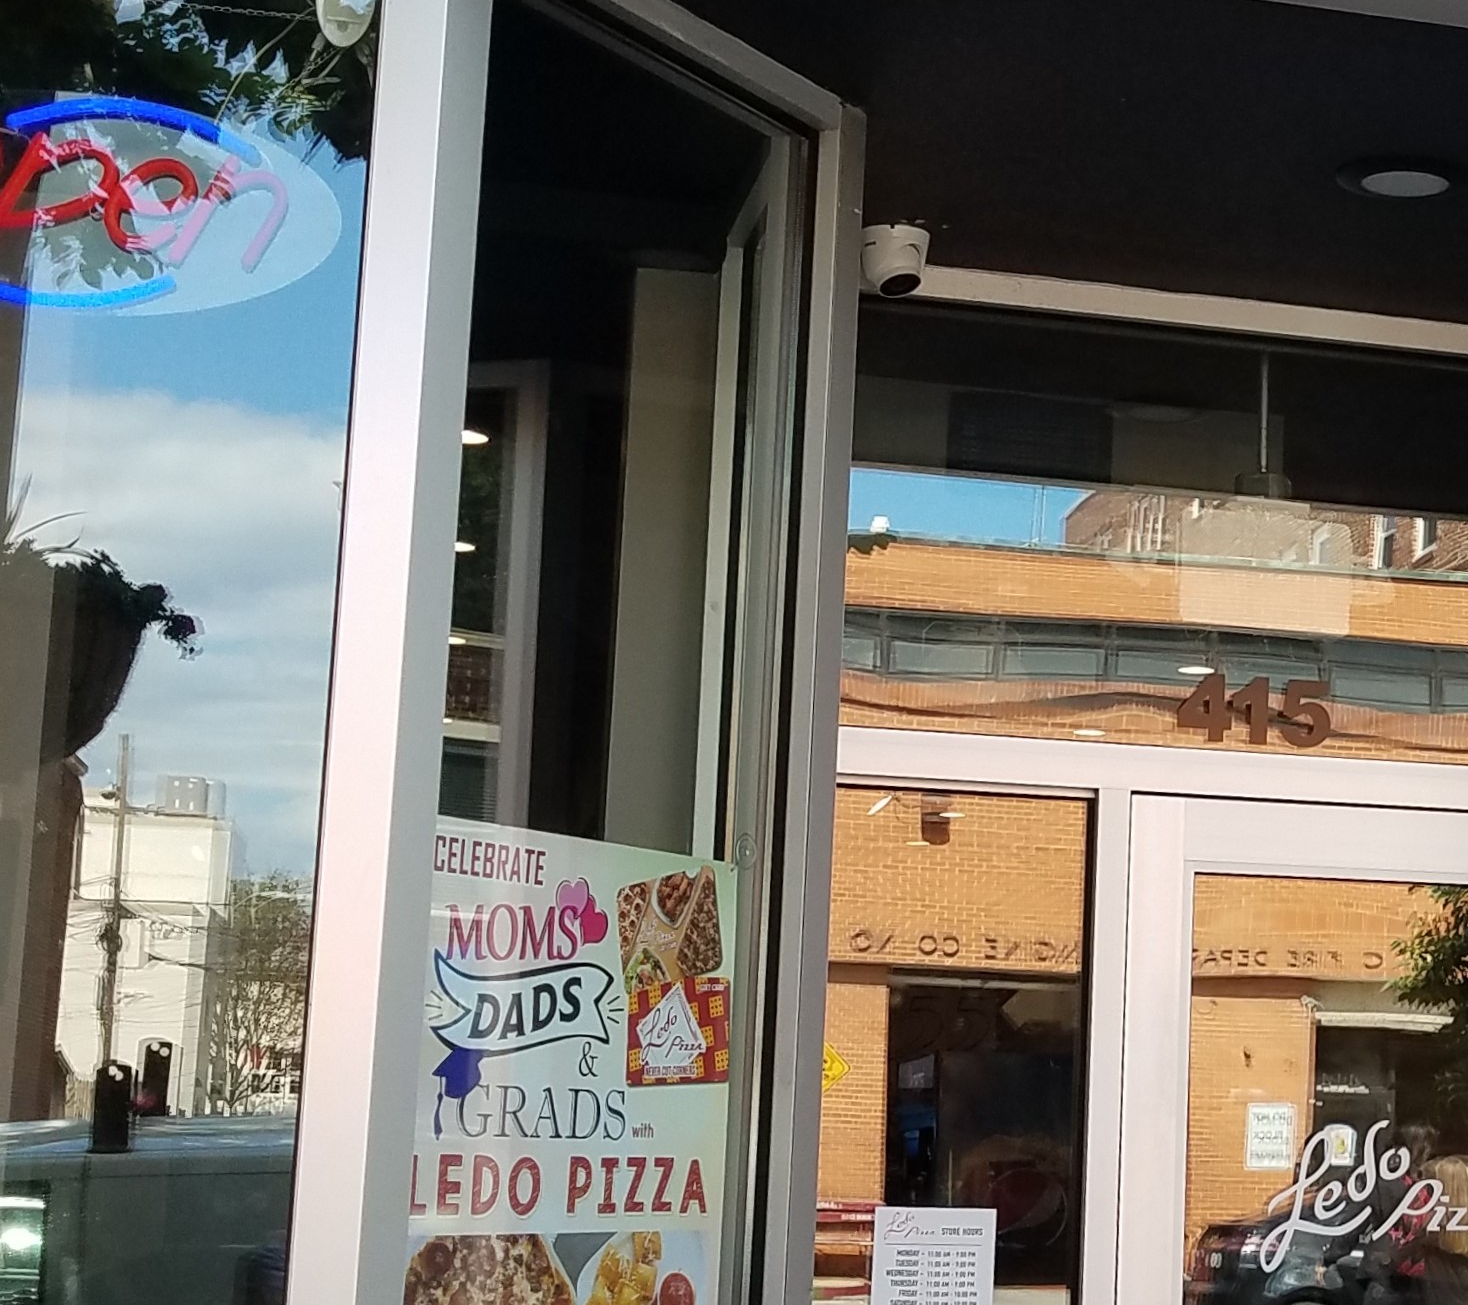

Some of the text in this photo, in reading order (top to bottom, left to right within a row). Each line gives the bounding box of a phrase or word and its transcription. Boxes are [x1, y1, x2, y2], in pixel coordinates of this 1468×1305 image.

[0, 131, 288, 273] pen
[1177, 674, 1332, 748] 415
[433, 835, 546, 886] CELEBRATE
[445, 904, 579, 961] MOMS
[467, 977, 583, 1040] DADS
[641, 1006, 678, 1063] Ledo
[579, 1041, 599, 1077] &
[665, 1036, 704, 1058] Pizza
[456, 1083, 627, 1141] GRADS
[631, 1123, 655, 1138] with
[409, 1154, 708, 1216] LEDO PIZZA
[1259, 1119, 1411, 1274] Ledo
[941, 1228, 960, 1236] STORE
[962, 1228, 983, 1236] HOURS
